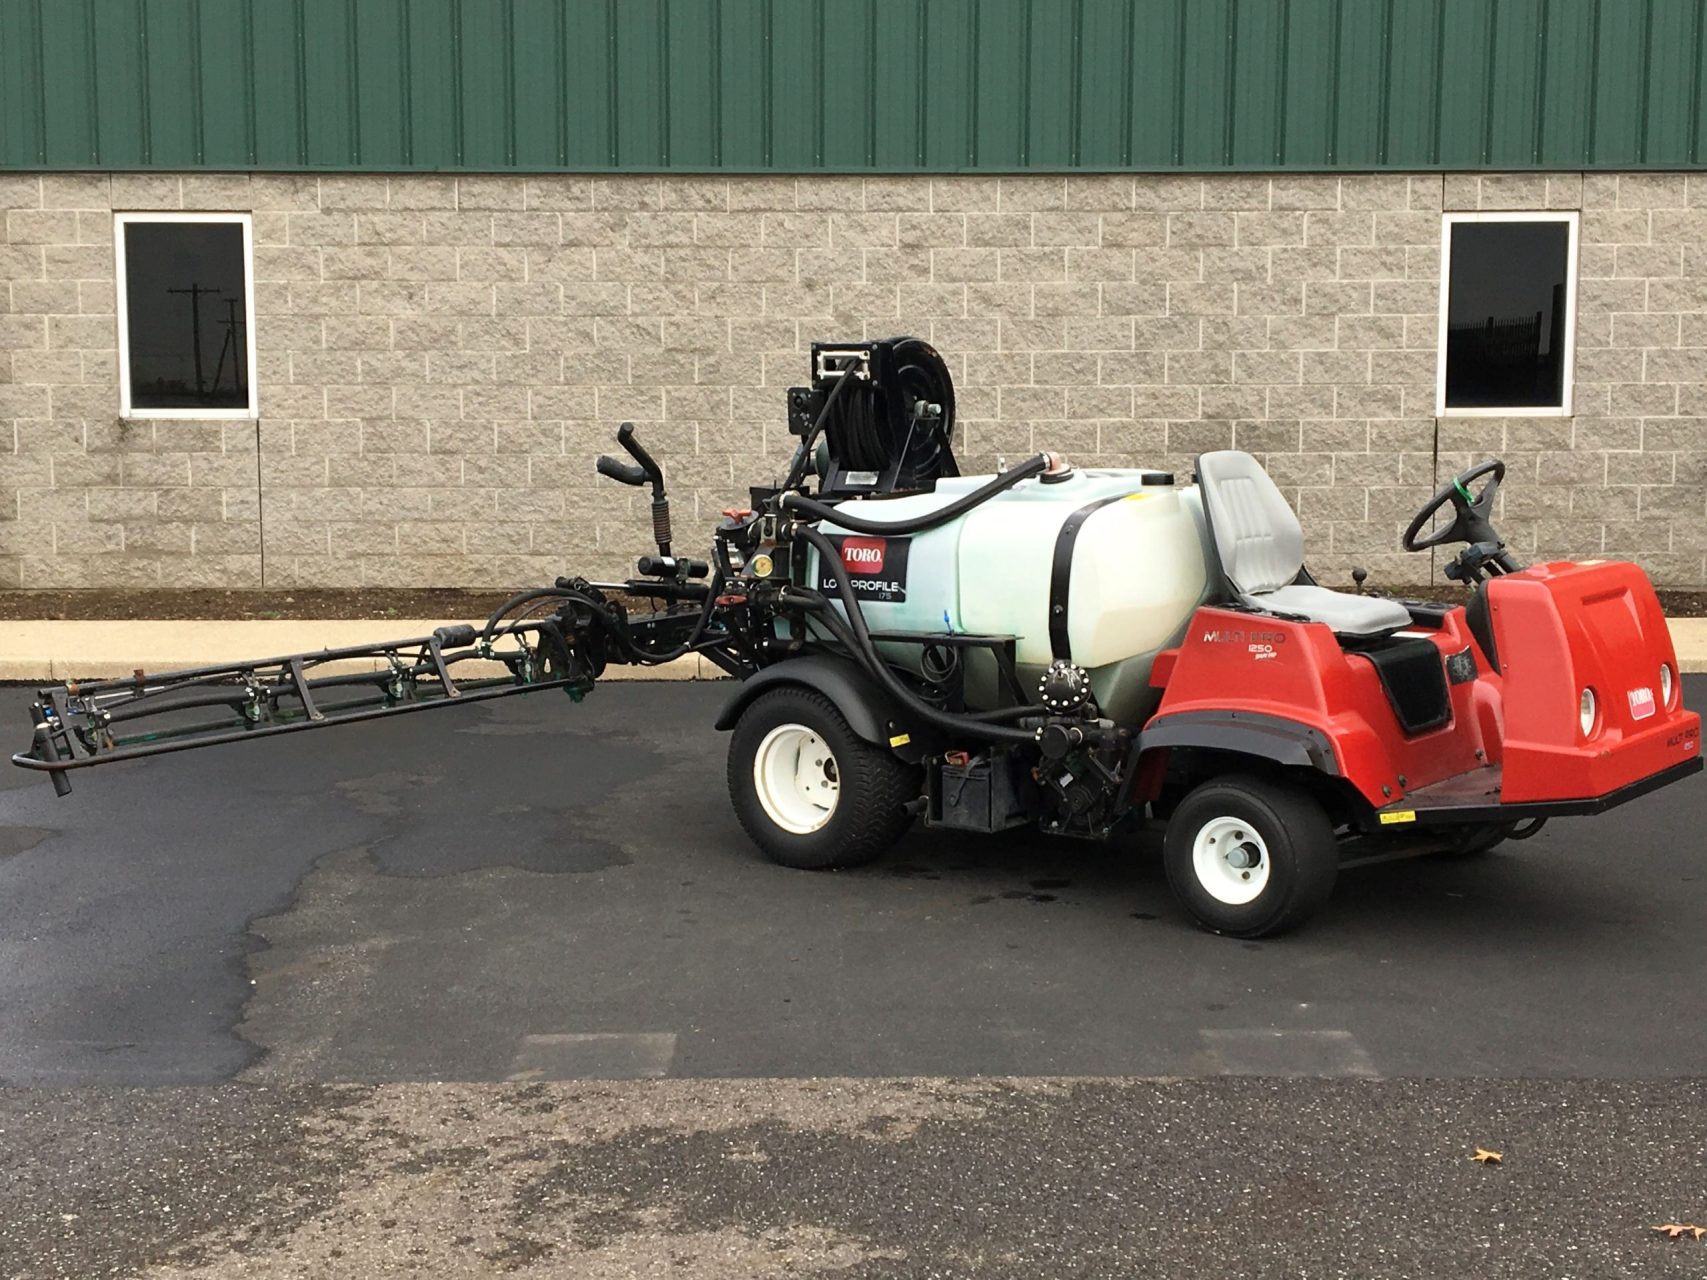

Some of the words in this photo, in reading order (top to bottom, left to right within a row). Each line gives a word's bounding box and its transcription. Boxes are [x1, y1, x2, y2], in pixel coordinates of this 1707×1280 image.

[844, 547, 882, 562] TORO
[851, 580, 899, 592] PROFILE
[1248, 643, 1273, 653] 1250
